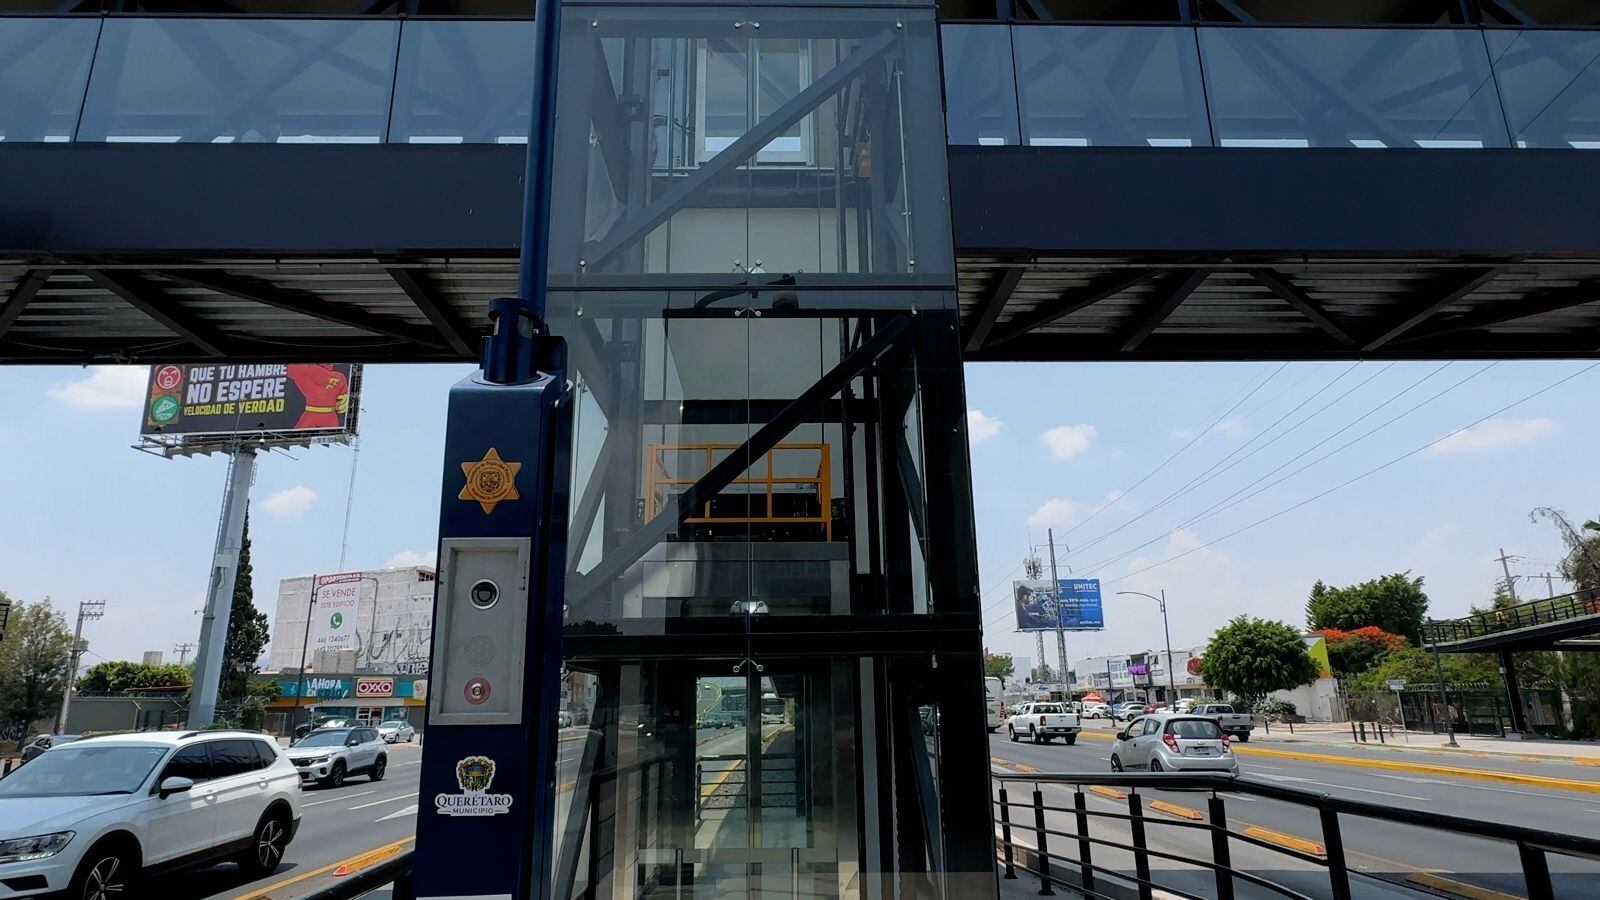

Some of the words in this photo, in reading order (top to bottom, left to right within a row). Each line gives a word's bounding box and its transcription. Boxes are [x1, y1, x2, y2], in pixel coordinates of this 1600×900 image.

[190, 366, 215, 382] QUE
[219, 365, 235, 379] TU
[238, 364, 287, 378] HAMBRE
[186, 383, 212, 404] NO
[216, 377, 286, 402] ESPERE
[183, 404, 222, 416] VELOCIDAD
[223, 403, 235, 414] DE
[238, 399, 285, 413] VERDAD
[322, 590, 330, 599] SE
[331, 587, 356, 598] VENDE
[332, 600, 355, 608] EDIFICIO
[358, 682, 392, 694] OXXO
[437, 794, 511, 808] QUERÉTARO
[452, 807, 494, 815] MUNICIPIO
